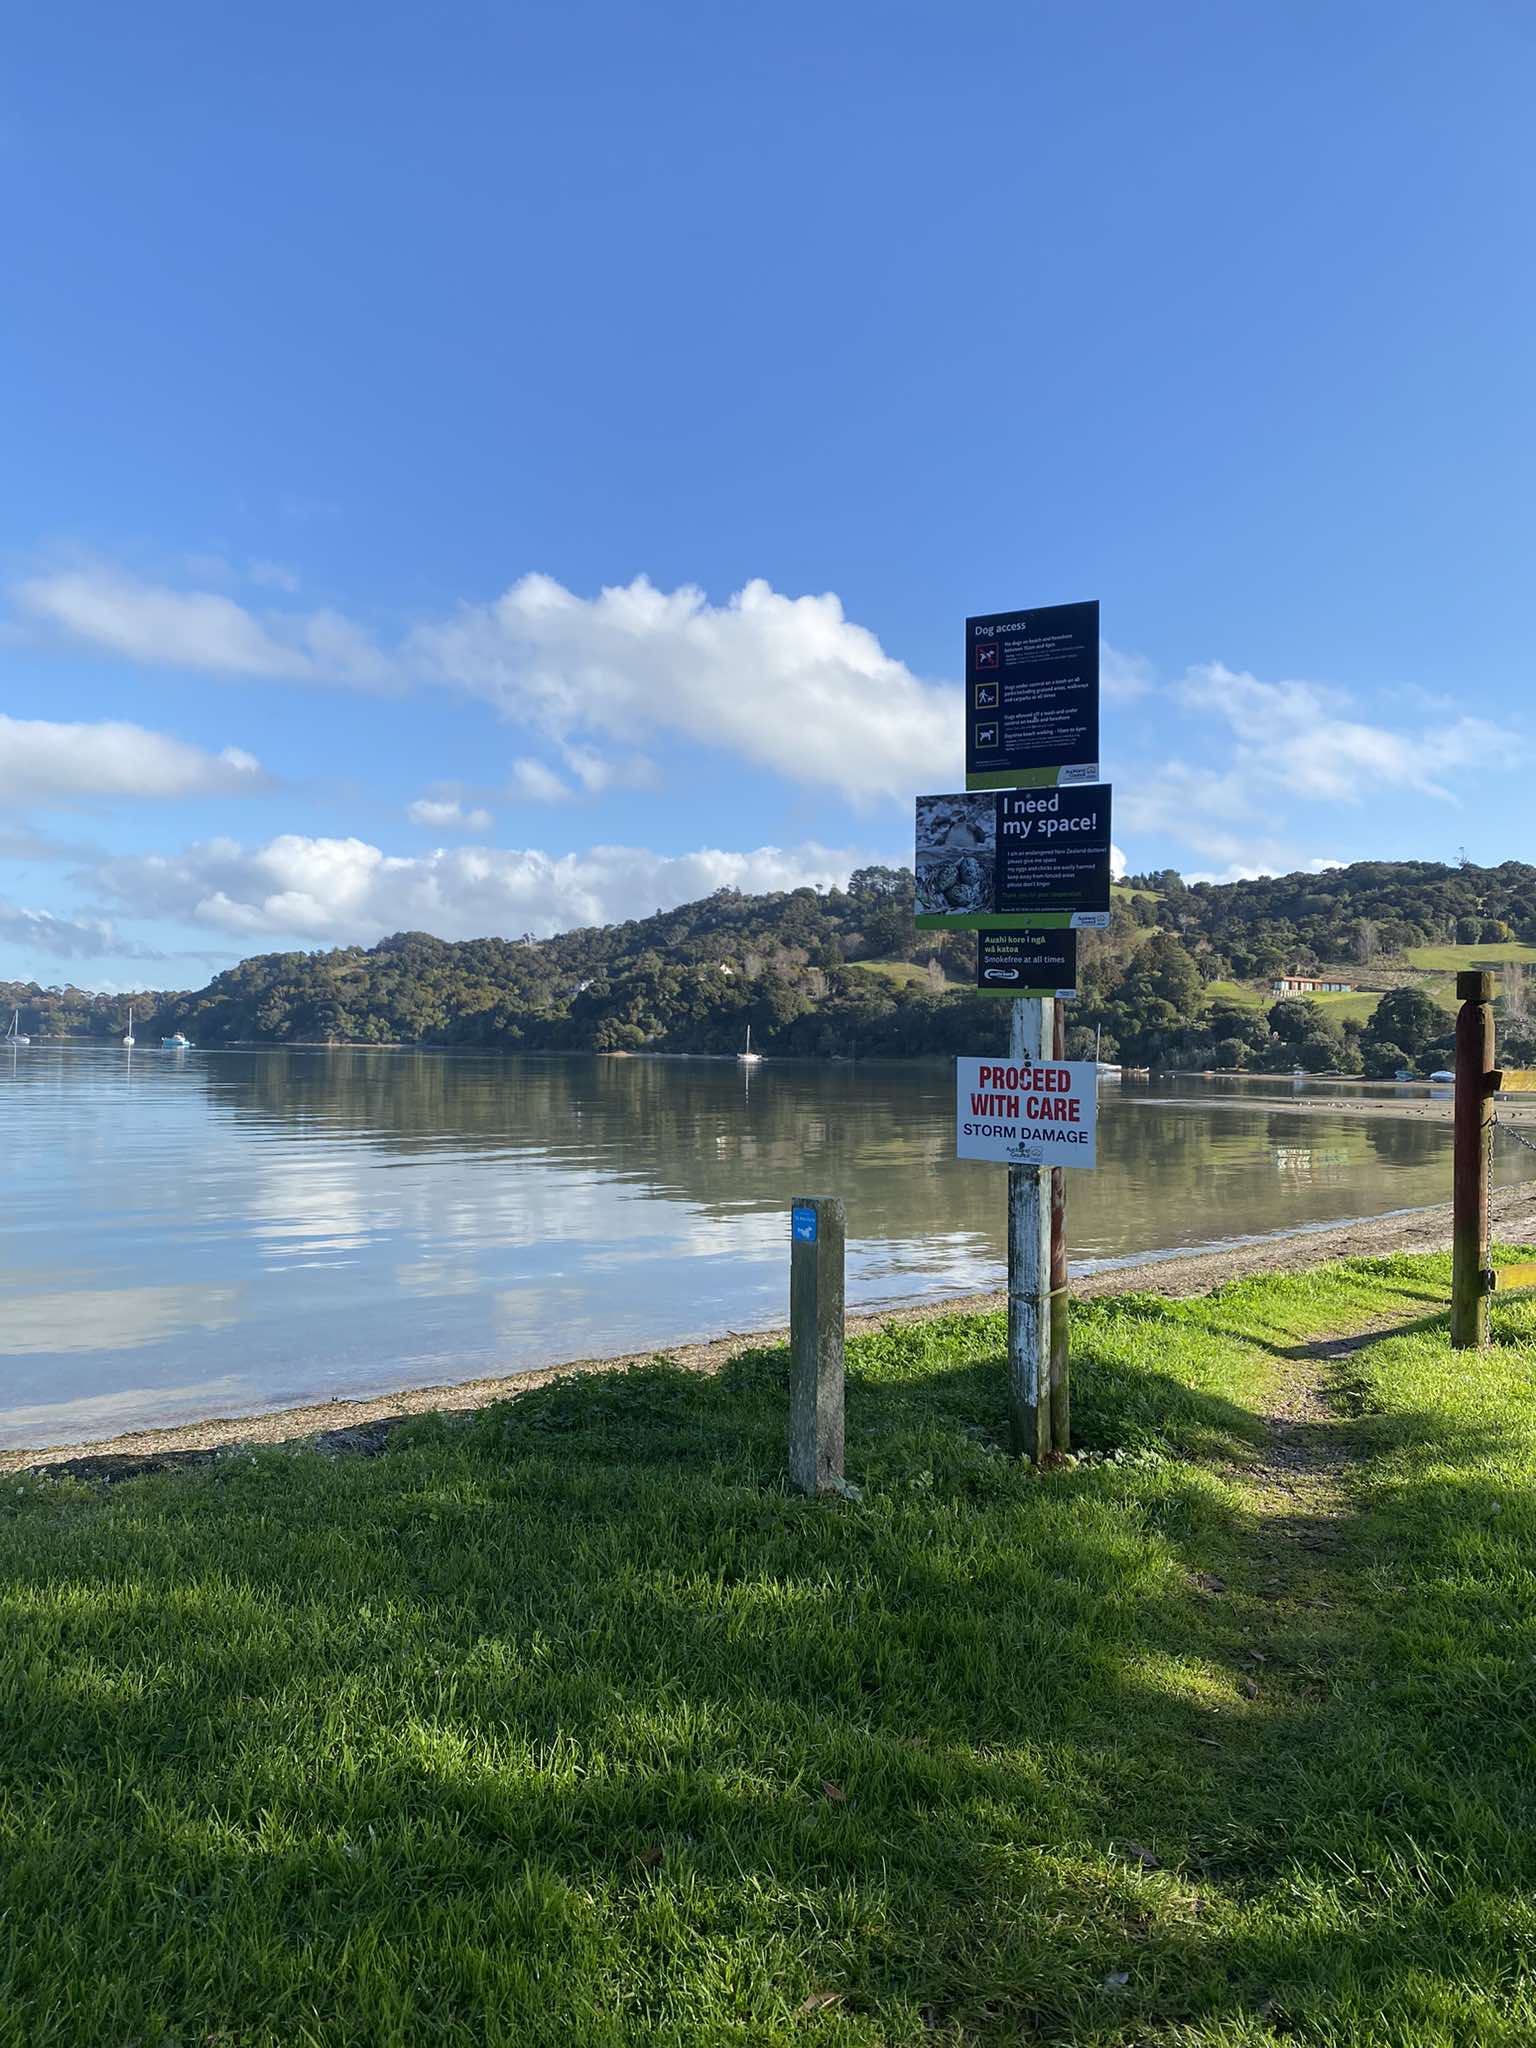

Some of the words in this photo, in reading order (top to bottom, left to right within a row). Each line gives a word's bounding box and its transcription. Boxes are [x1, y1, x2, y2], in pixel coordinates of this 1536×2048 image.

[975, 626, 994, 637] Dog
[997, 622, 1026, 633] access
[1004, 797, 1008, 815] I
[1015, 793, 1059, 814] need
[1004, 820, 1032, 839] my
[1038, 812, 1097, 838] space!
[985, 936, 1007, 944] Auahi
[1008, 935, 1026, 943] kore
[997, 945, 1019, 953] katoa
[984, 955, 1023, 964] Smokefree
[1024, 956, 1032, 964] at
[1032, 956, 1043, 964] all
[1044, 955, 1065, 964] times
[980, 1066, 1071, 1093] PROCEED
[971, 1093, 1019, 1118] WITH
[1027, 1096, 1081, 1122] CARE
[964, 1123, 1017, 1139] STORM
[1021, 1127, 1089, 1144] DAMAGE
